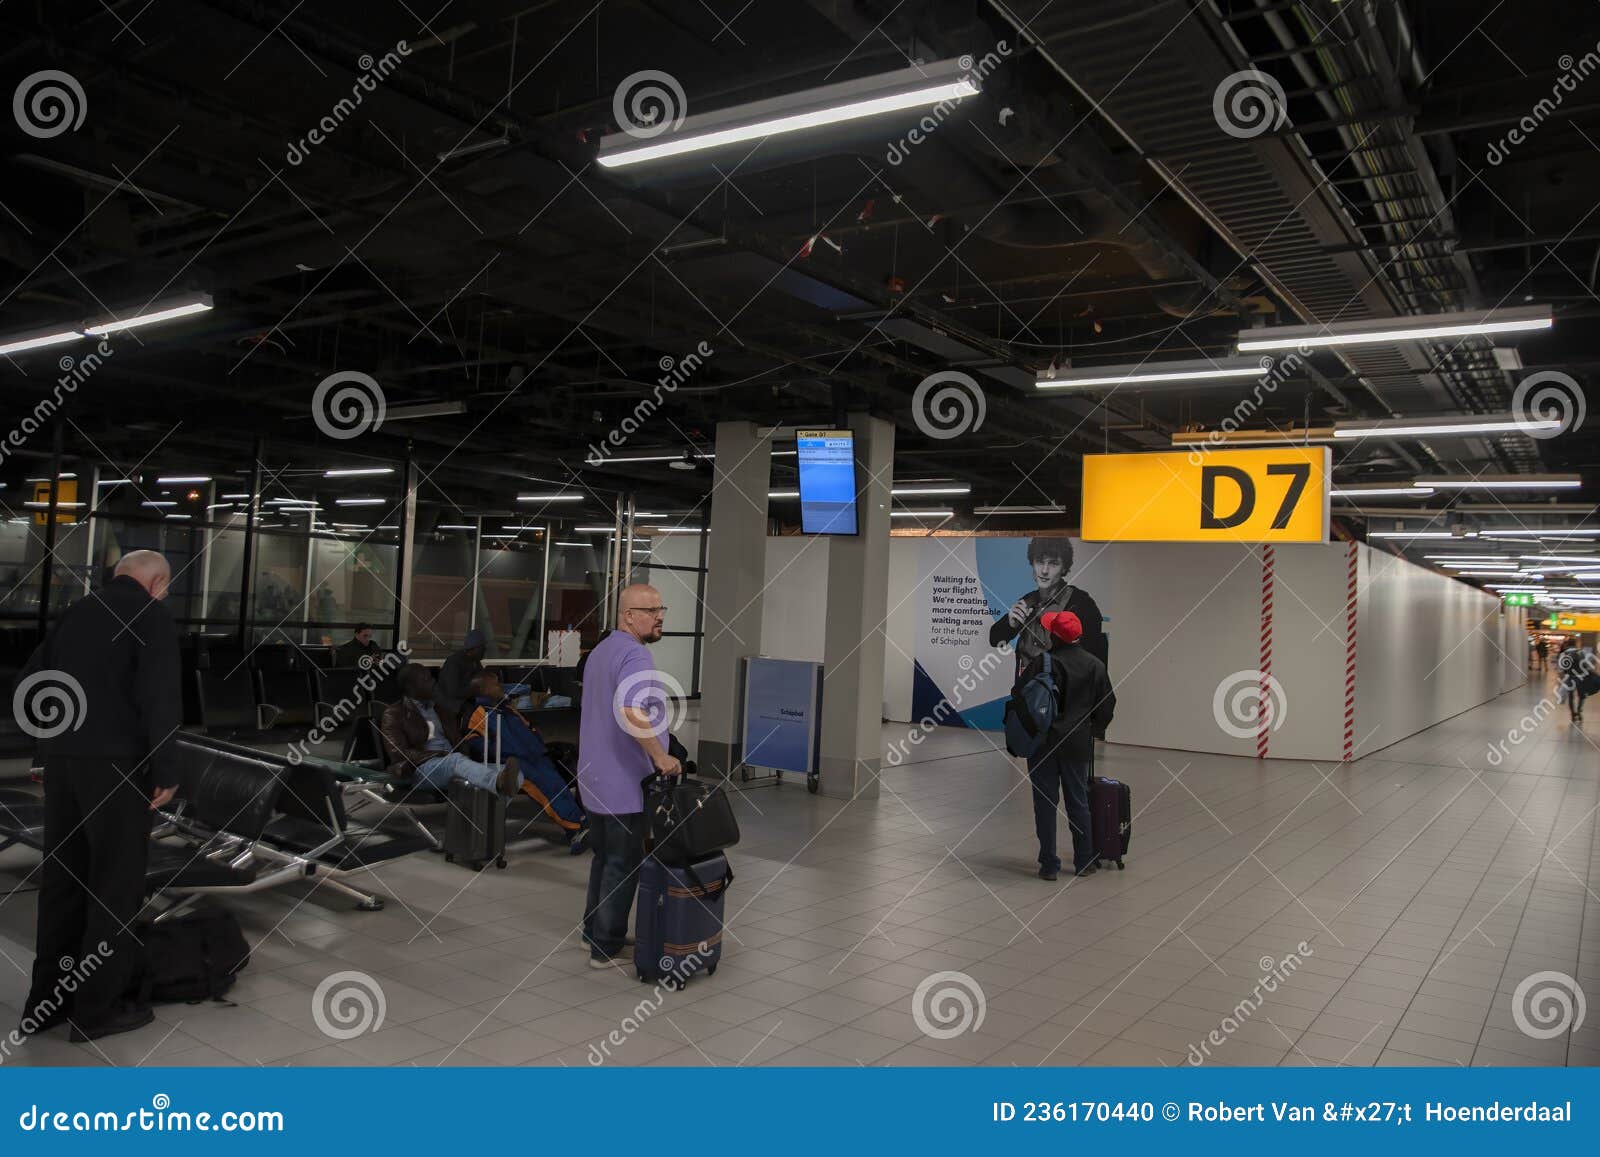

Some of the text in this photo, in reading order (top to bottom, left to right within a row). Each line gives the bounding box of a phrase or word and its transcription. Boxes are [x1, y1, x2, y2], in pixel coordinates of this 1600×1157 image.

[1200, 463, 1310, 529] D7
[933, 576, 976, 585] Waiting for
[952, 586, 977, 595] flight?
[932, 596, 988, 606] We're creating
[953, 607, 1001, 616] comfortable
[931, 617, 961, 626] waiting
[931, 626, 979, 636] for the future
[939, 637, 970, 647] Schiphol
